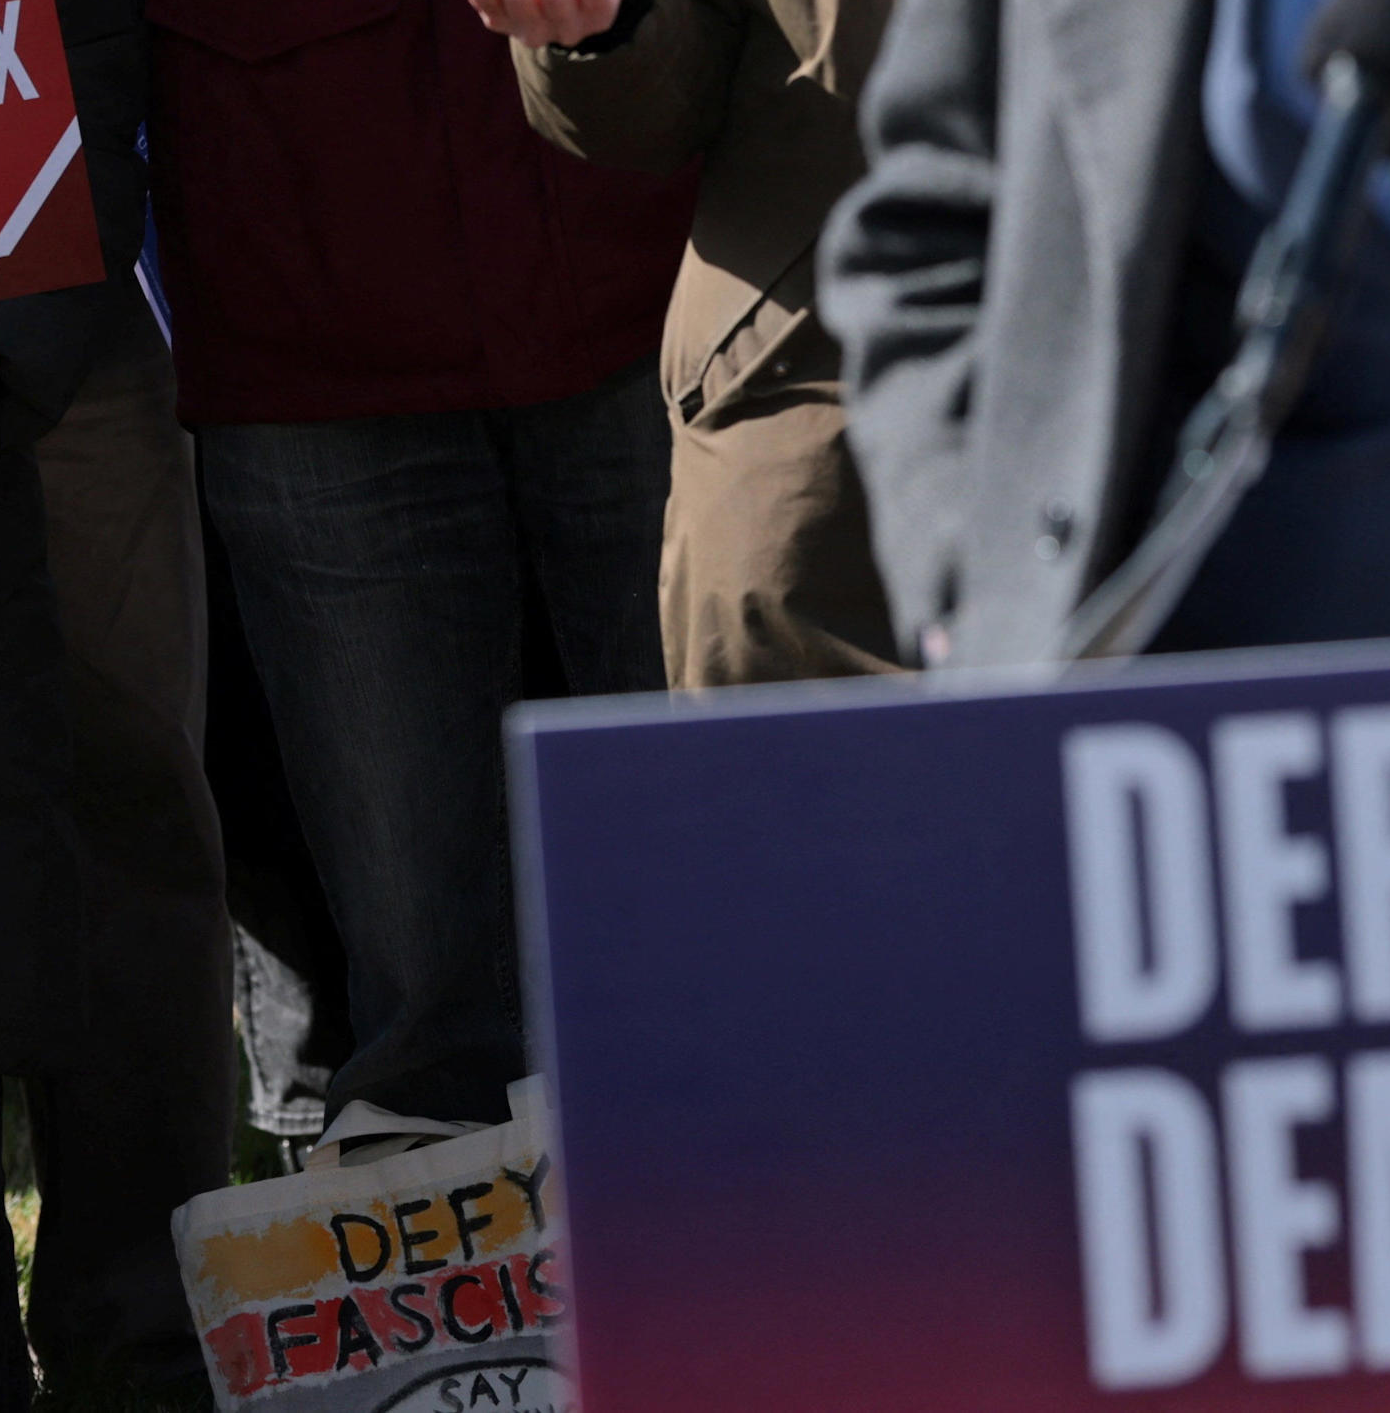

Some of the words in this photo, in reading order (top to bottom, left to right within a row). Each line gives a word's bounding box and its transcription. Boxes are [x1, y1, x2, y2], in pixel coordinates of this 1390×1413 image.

[331, 1152, 551, 1284] DEFY
[266, 1248, 565, 1380] FASCIS
[434, 1367, 528, 1413] SAY
